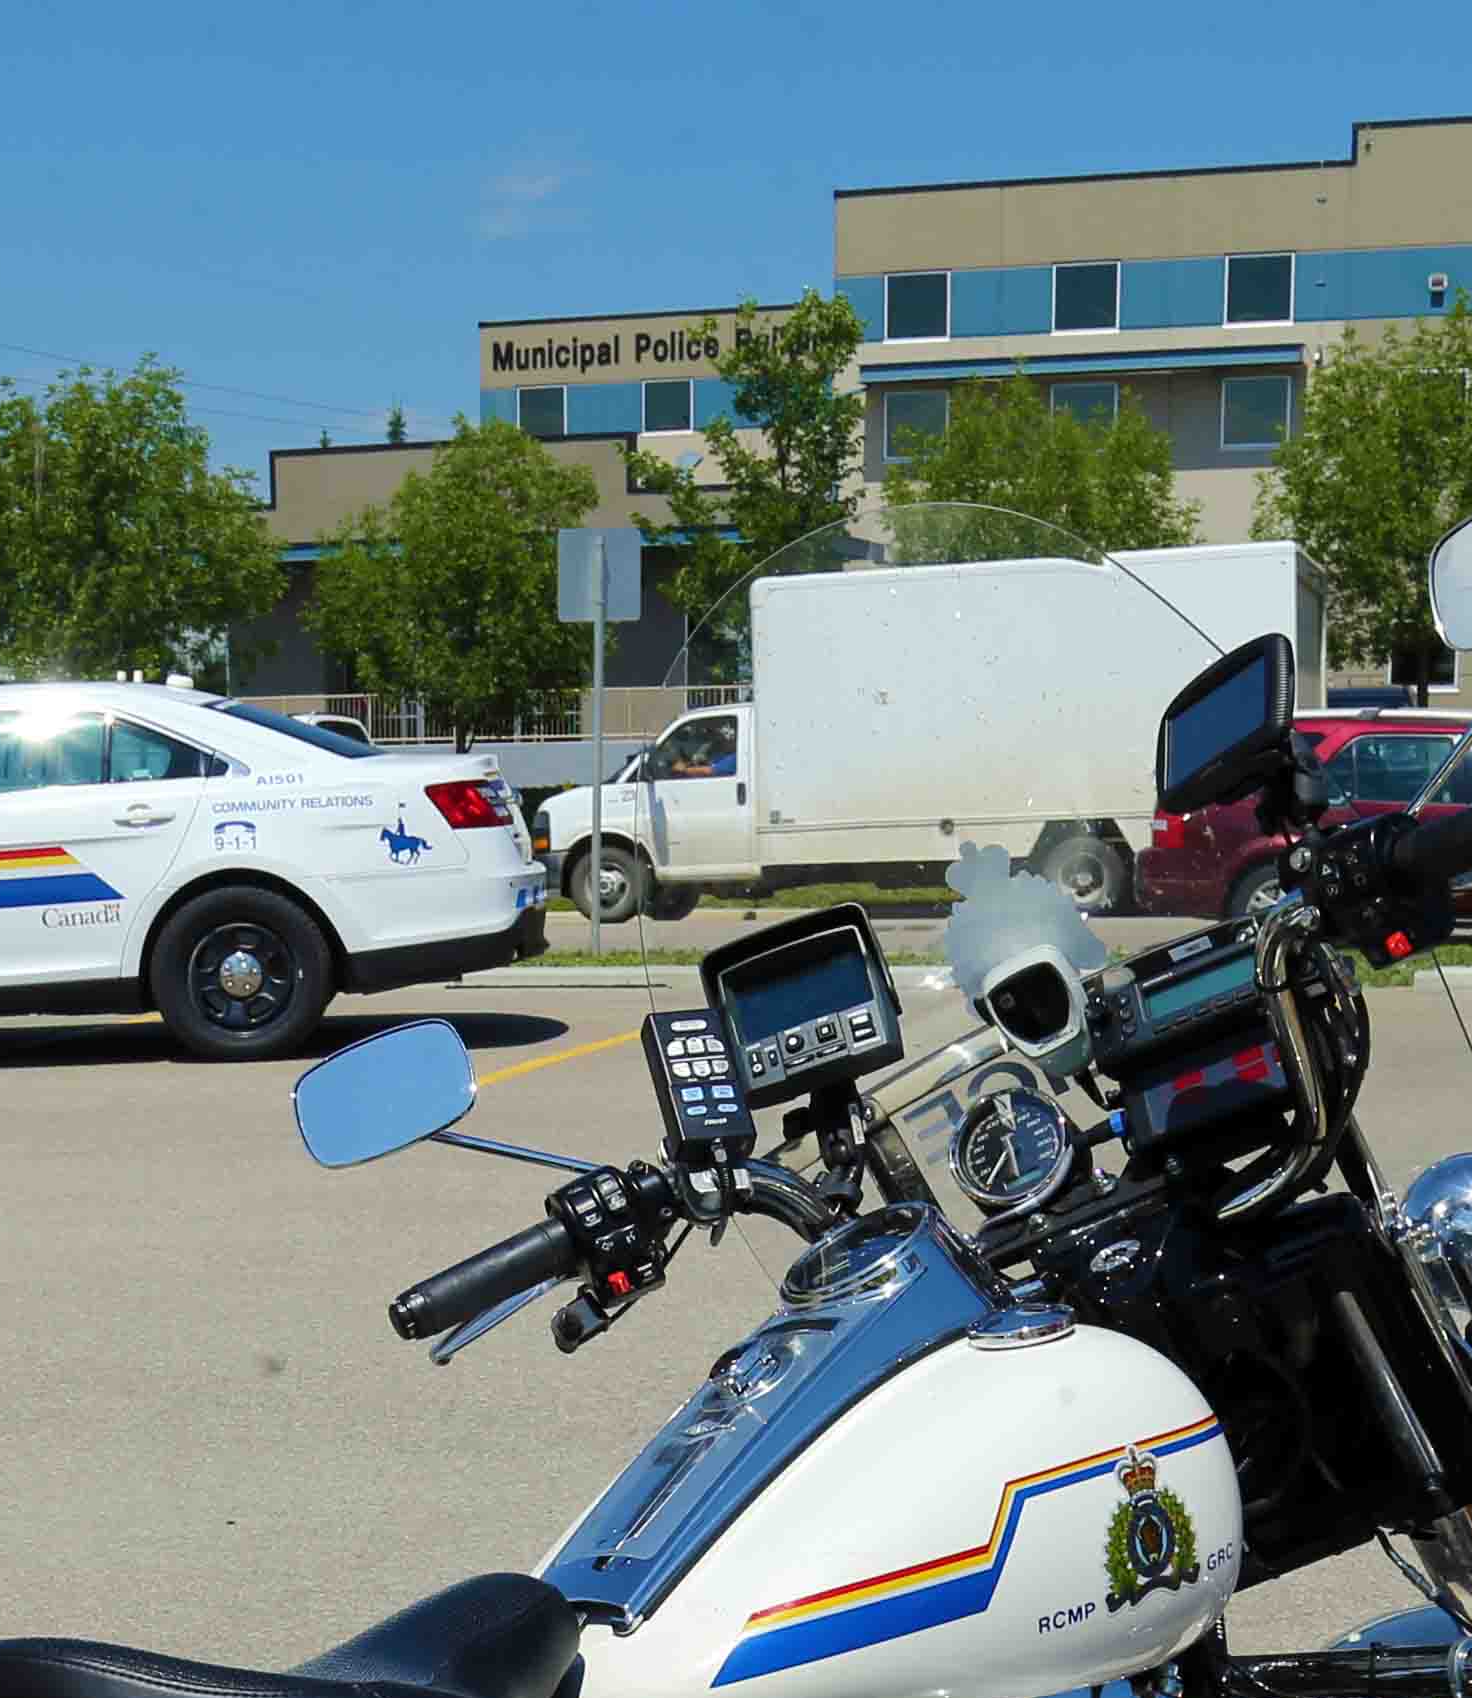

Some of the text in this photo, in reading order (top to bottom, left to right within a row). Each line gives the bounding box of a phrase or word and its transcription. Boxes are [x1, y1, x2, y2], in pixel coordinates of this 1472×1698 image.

[492, 335, 620, 373] Municipal
[635, 330, 720, 363] Police
[212, 794, 374, 814] COMMUNITY RELATIONS
[214, 836, 257, 851] 9-1-1
[41, 903, 121, 928] Canada
[1037, 1543, 1233, 1634] RCMP GRC
